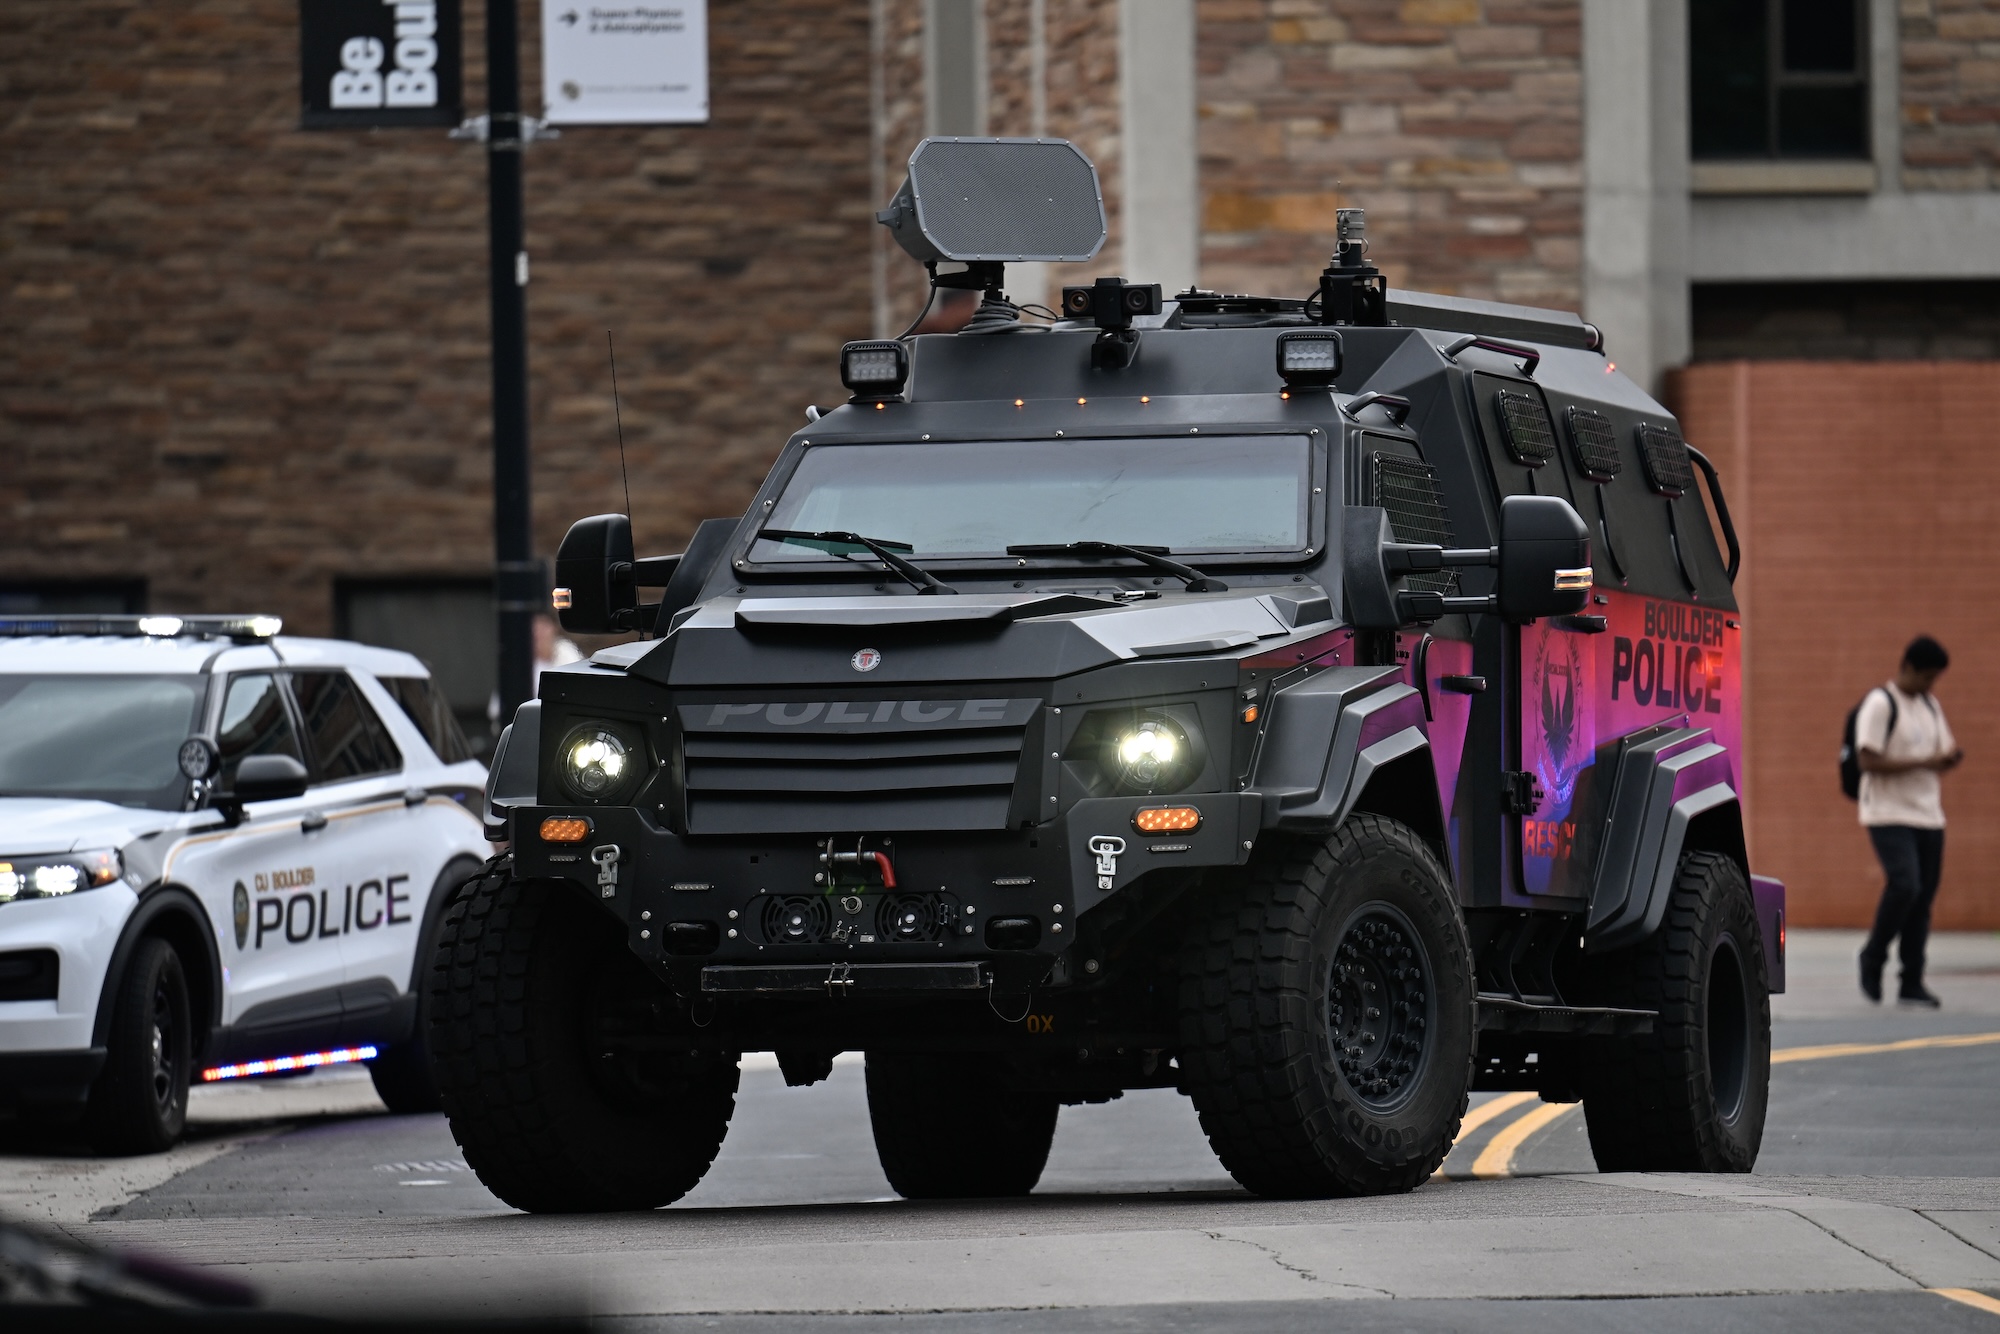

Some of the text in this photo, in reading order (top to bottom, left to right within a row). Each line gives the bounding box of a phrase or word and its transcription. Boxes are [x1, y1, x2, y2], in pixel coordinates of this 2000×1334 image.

[330, 36, 384, 108] Be
[1644, 601, 1724, 648] BOULDER
[1611, 636, 1724, 714] POLICE
[1524, 820, 1588, 862] RESC
[255, 867, 315, 892] CU BOULDER
[255, 874, 412, 950] POLICE
